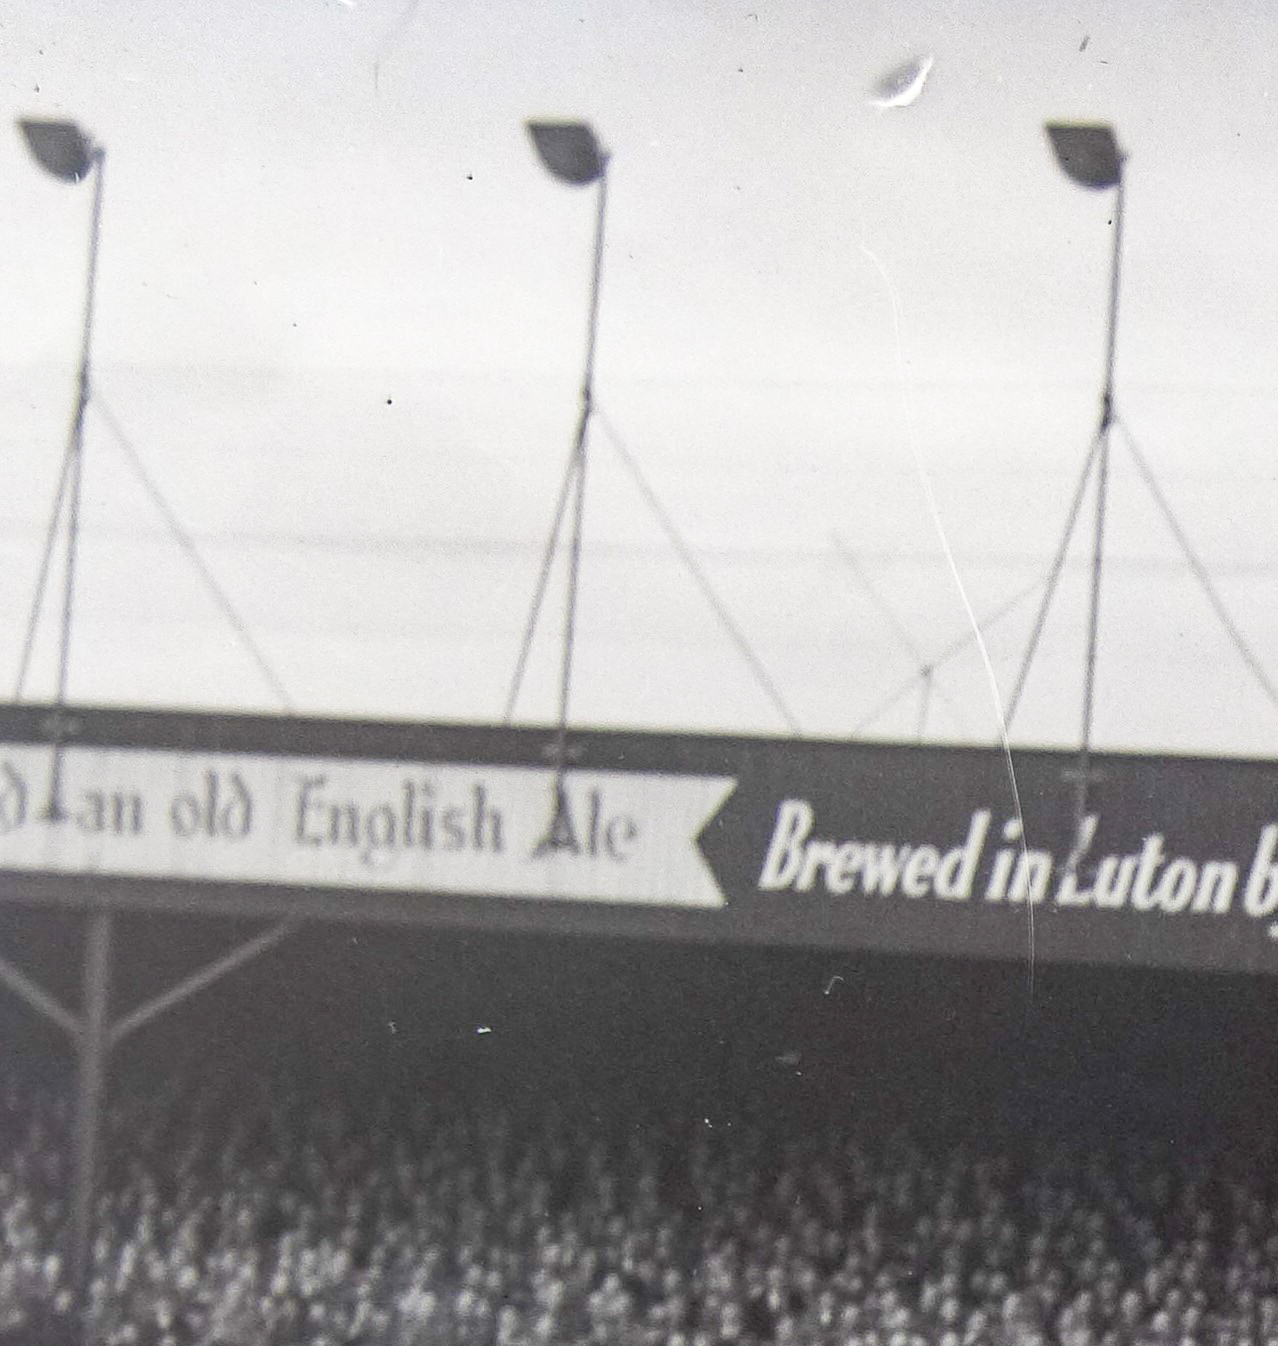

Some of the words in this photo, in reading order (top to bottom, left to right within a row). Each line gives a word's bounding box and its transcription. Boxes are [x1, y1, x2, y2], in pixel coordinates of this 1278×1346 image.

[76, 791, 143, 836] an
[170, 769, 251, 837] old
[296, 774, 506, 868] English
[534, 772, 640, 862] Ale
[757, 799, 992, 900] Brewed
[985, 818, 1054, 903] in
[1055, 815, 1238, 913] Luton
